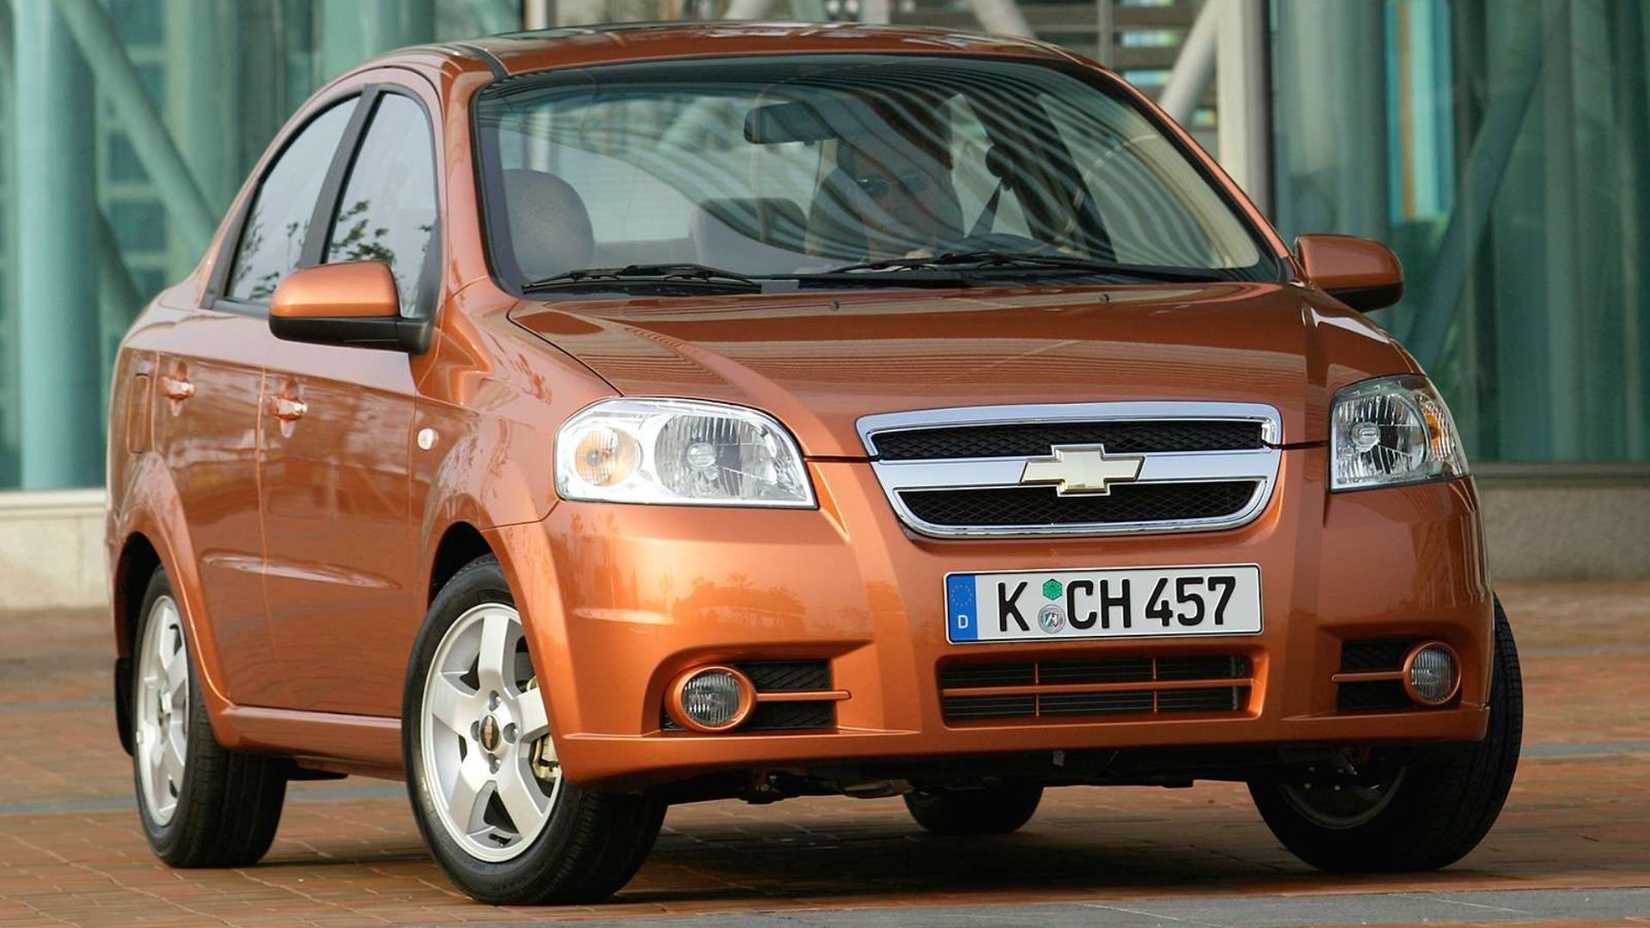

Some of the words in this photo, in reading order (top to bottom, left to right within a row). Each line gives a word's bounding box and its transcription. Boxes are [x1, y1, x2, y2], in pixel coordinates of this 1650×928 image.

[958, 614, 969, 629] D
[997, 581, 1030, 632] K
[1066, 578, 1132, 630] CH
[1145, 576, 1236, 627] 457
